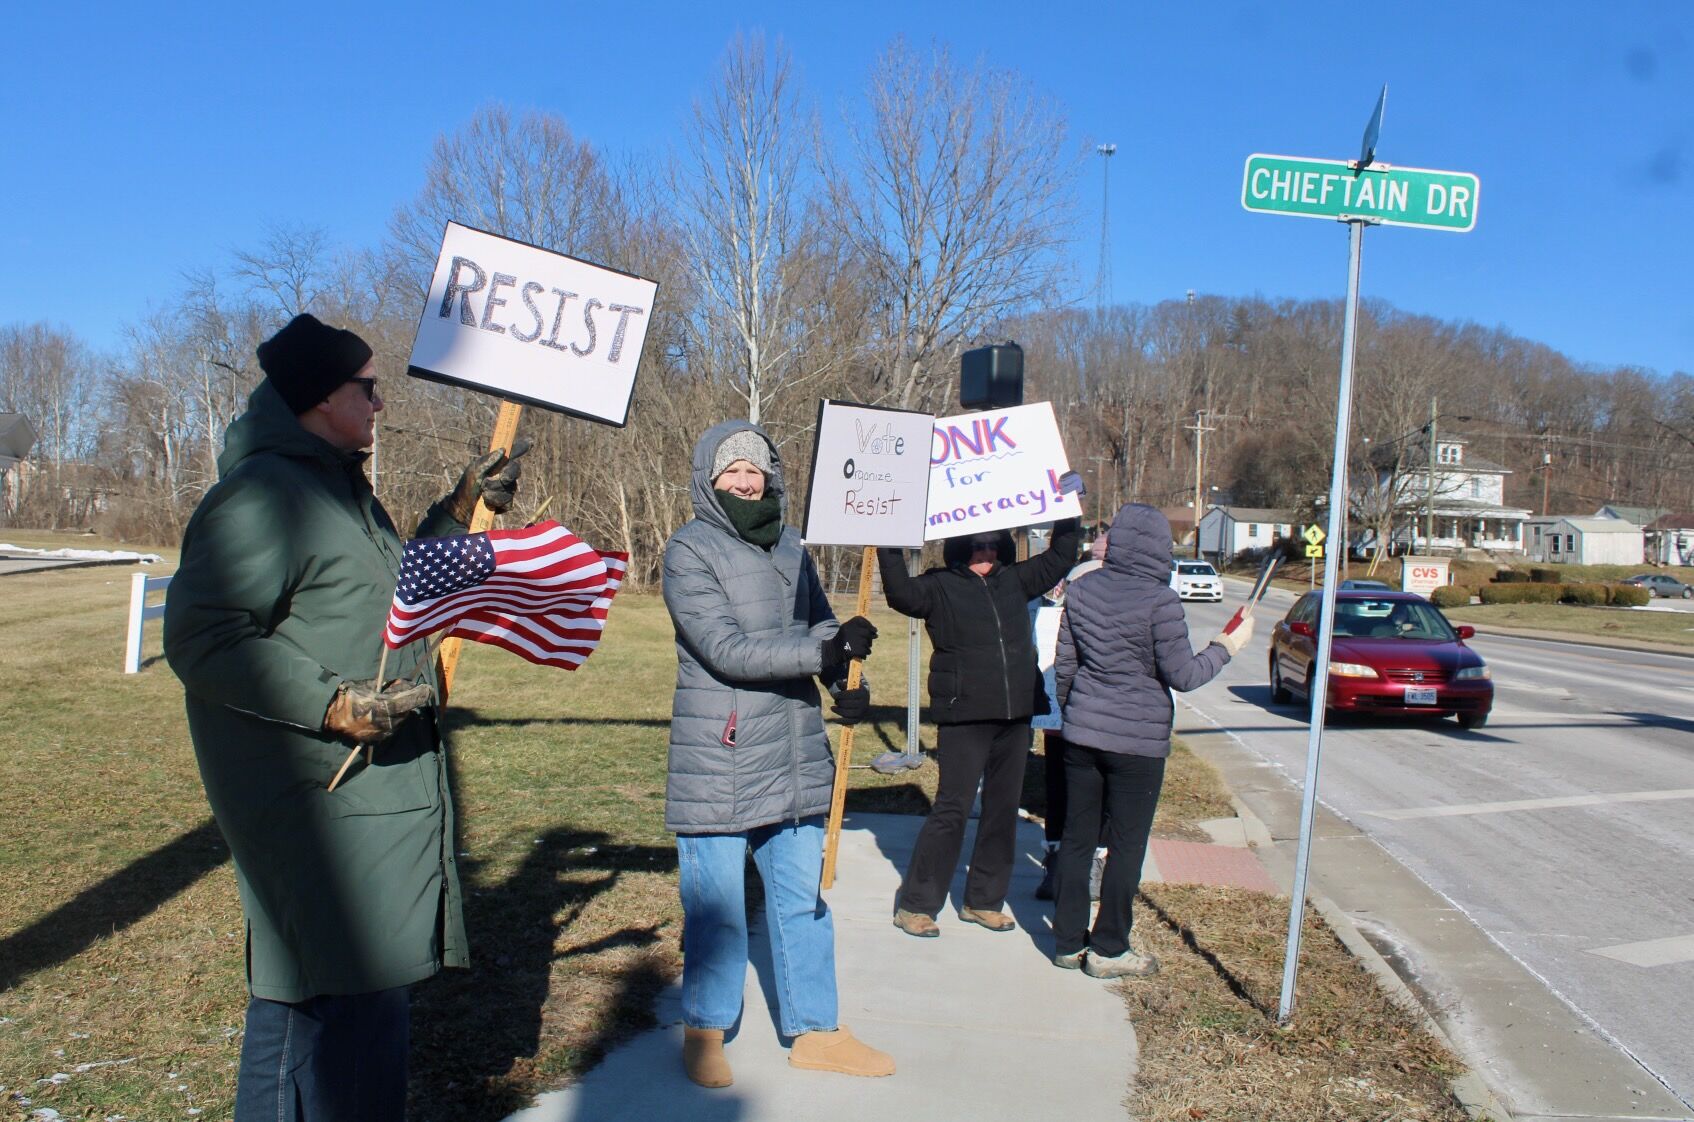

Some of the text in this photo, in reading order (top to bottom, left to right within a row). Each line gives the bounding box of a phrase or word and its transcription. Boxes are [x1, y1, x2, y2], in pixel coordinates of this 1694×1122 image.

[1251, 167, 1470, 218] CHIEFTAIN DR
[439, 256, 644, 363] RESIST
[855, 418, 905, 455] Vote
[843, 458, 893, 492] Organize
[944, 467, 991, 488] for
[844, 489, 902, 515] Resist
[925, 469, 1064, 526] mocracy!
[1412, 567, 1438, 578] CVS
